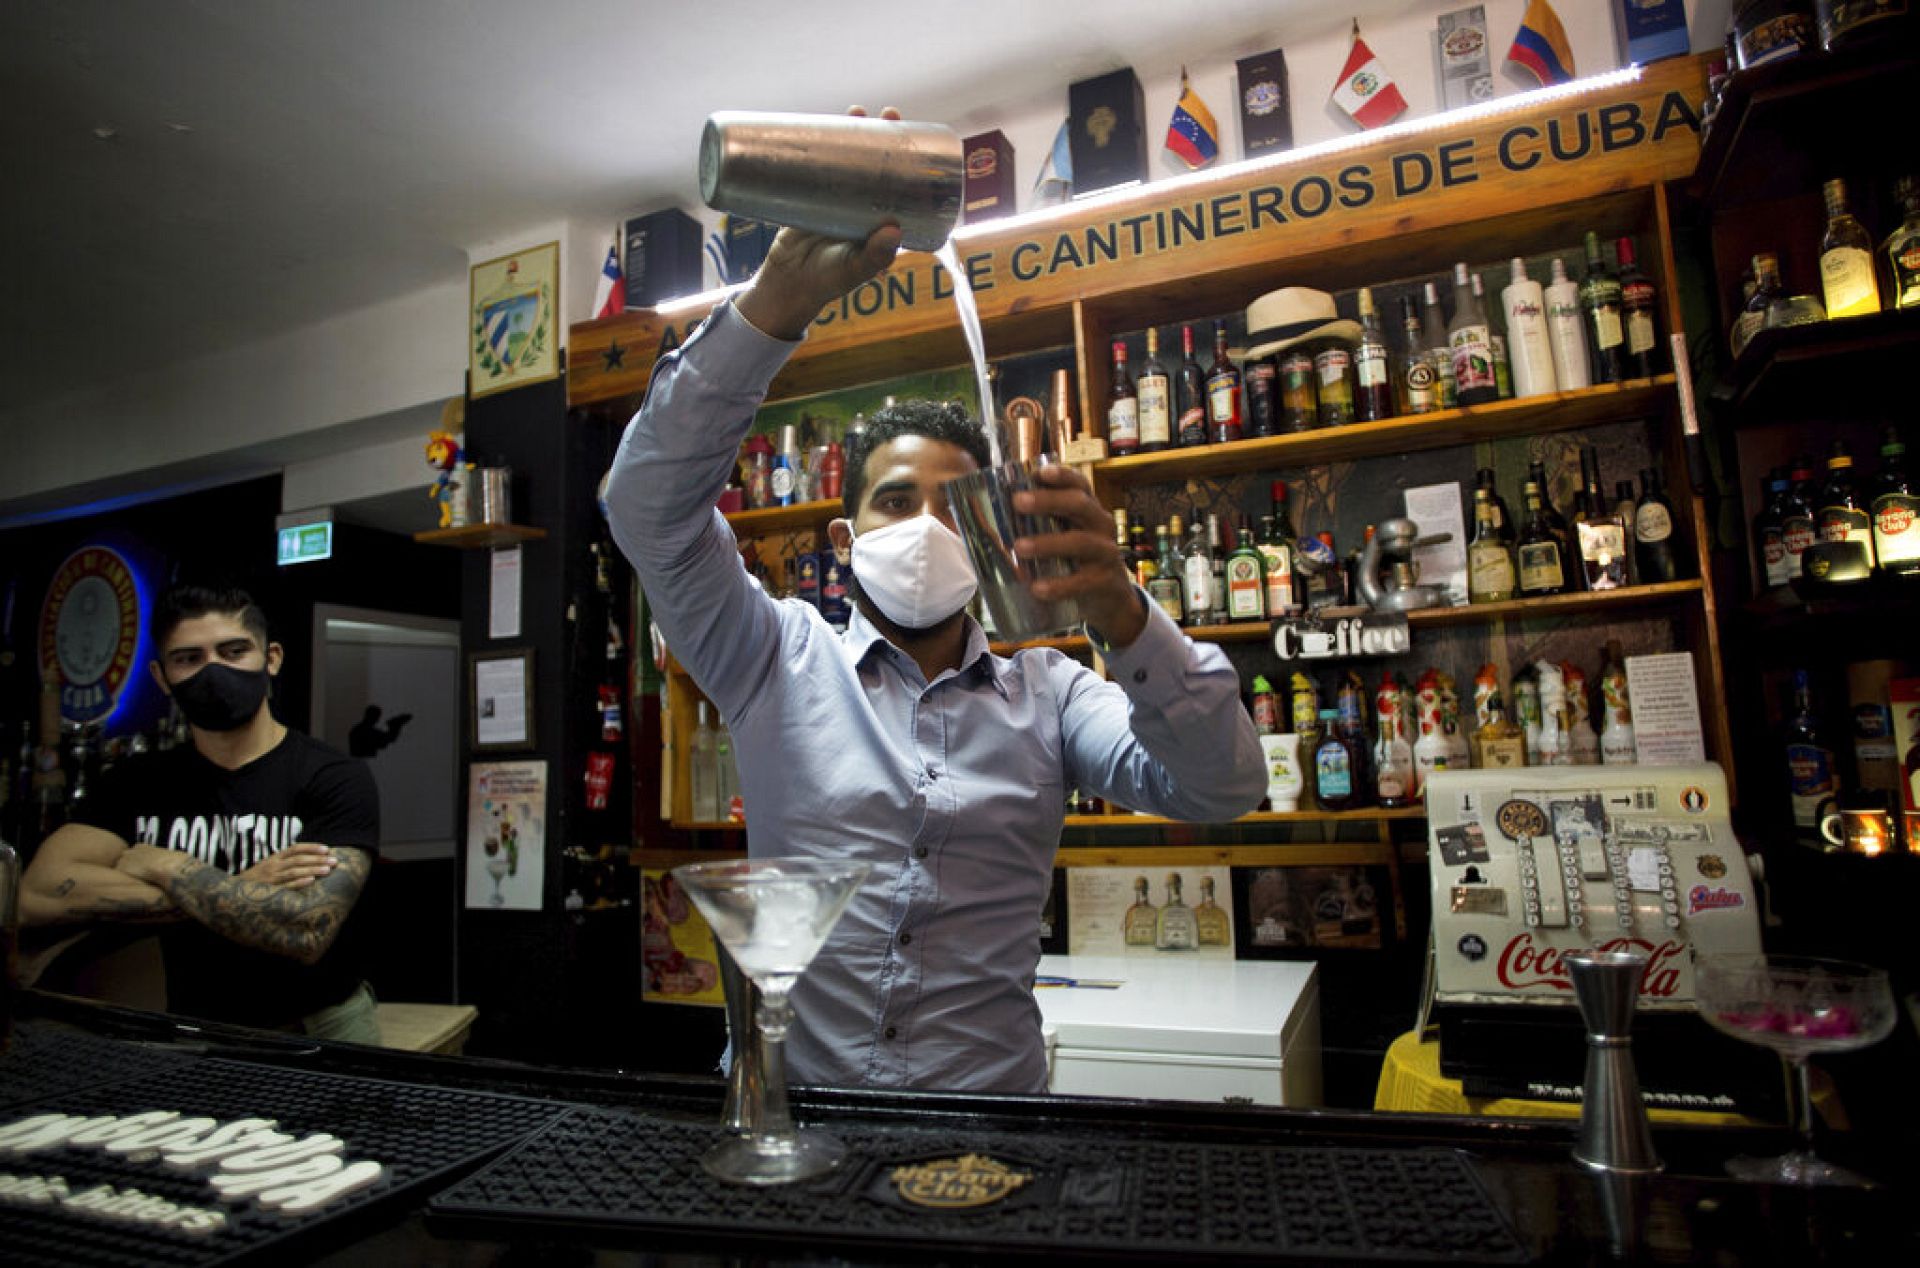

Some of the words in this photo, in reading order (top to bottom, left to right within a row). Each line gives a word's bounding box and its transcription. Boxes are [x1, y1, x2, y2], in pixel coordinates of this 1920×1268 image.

[1010, 164, 1375, 281] CANTINEROS
[1392, 139, 1479, 198] DE
[1498, 91, 1702, 172] CUBA
